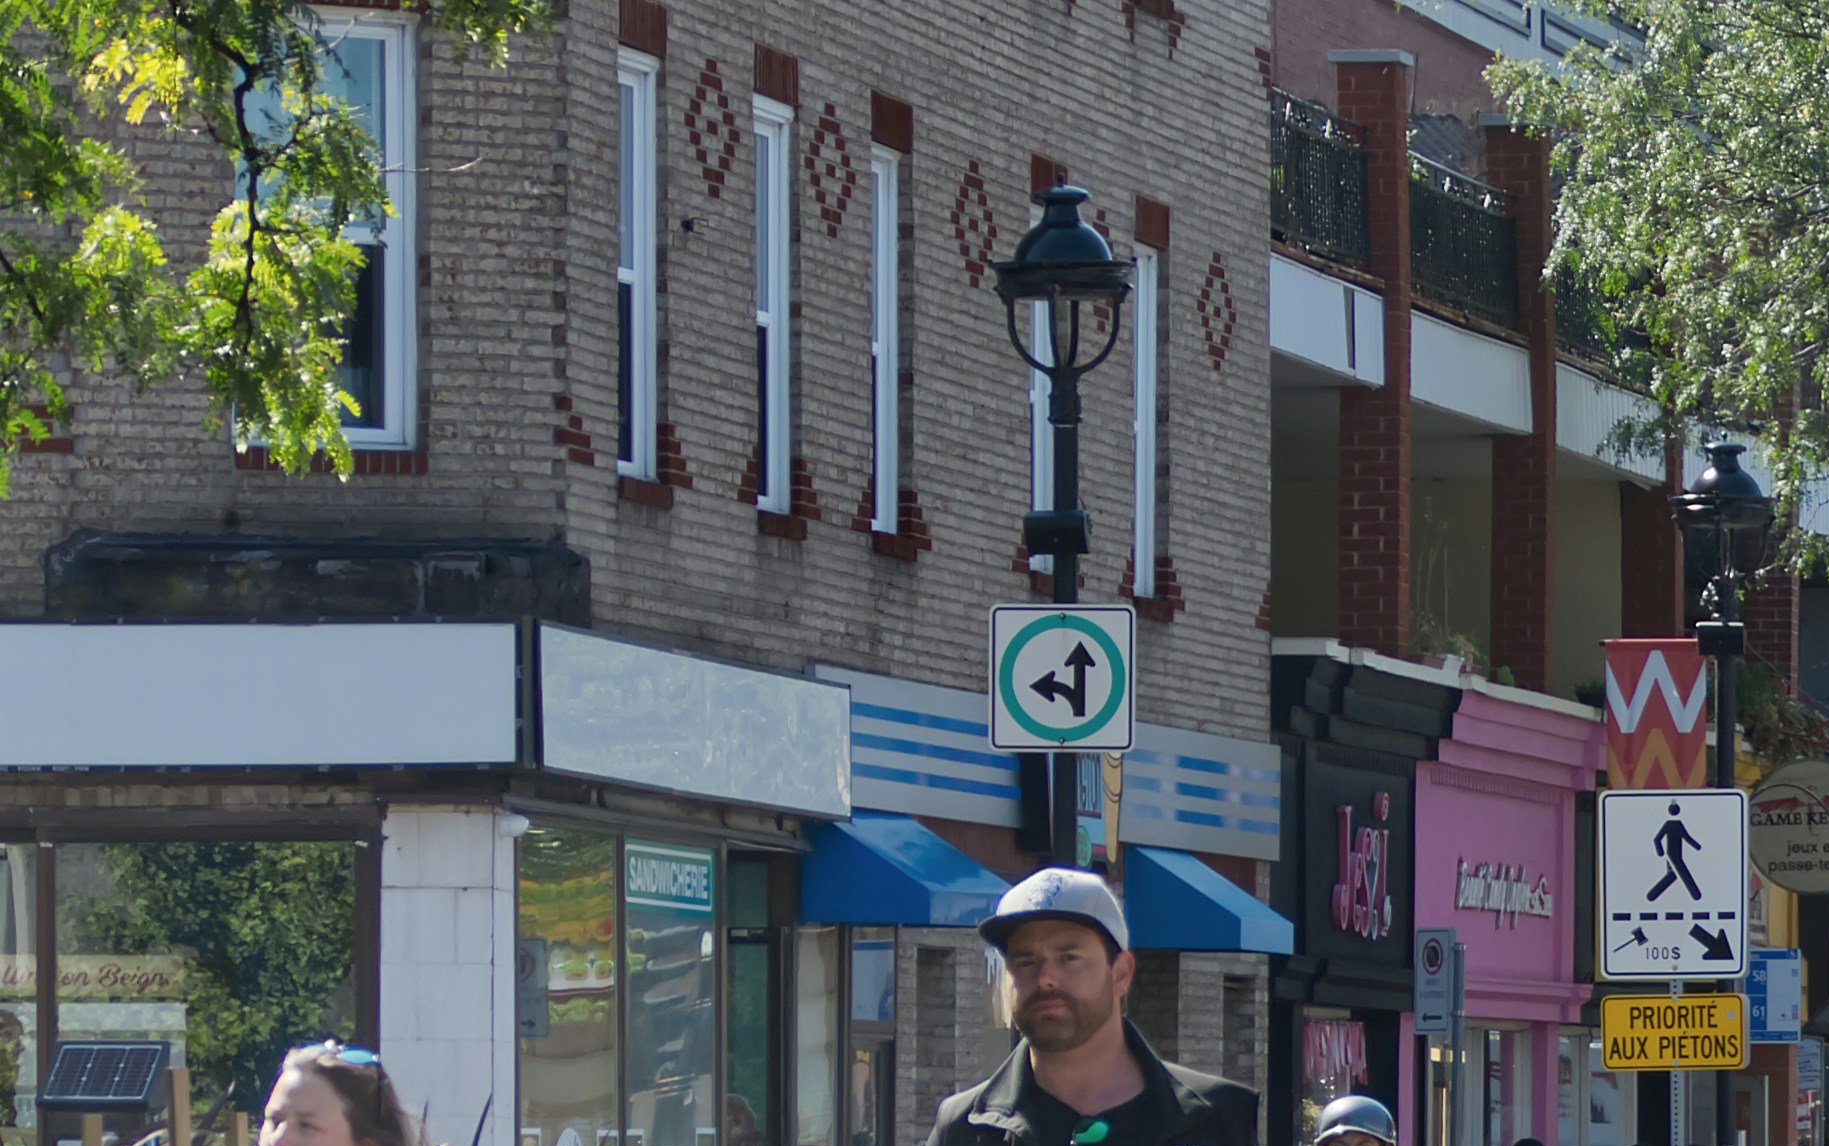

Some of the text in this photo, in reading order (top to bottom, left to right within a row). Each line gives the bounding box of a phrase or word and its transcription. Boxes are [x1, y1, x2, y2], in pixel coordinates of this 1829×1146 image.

[1750, 812, 1802, 827] GAME
[1787, 841, 1819, 858] jeux
[628, 856, 708, 900] SANDWICHERIE
[1752, 969, 1767, 982] 58
[1629, 1000, 1718, 1030] PRIORITÉ
[1751, 1005, 1766, 1018] 61
[1609, 1030, 1739, 1061] AUX PIÉTONS
